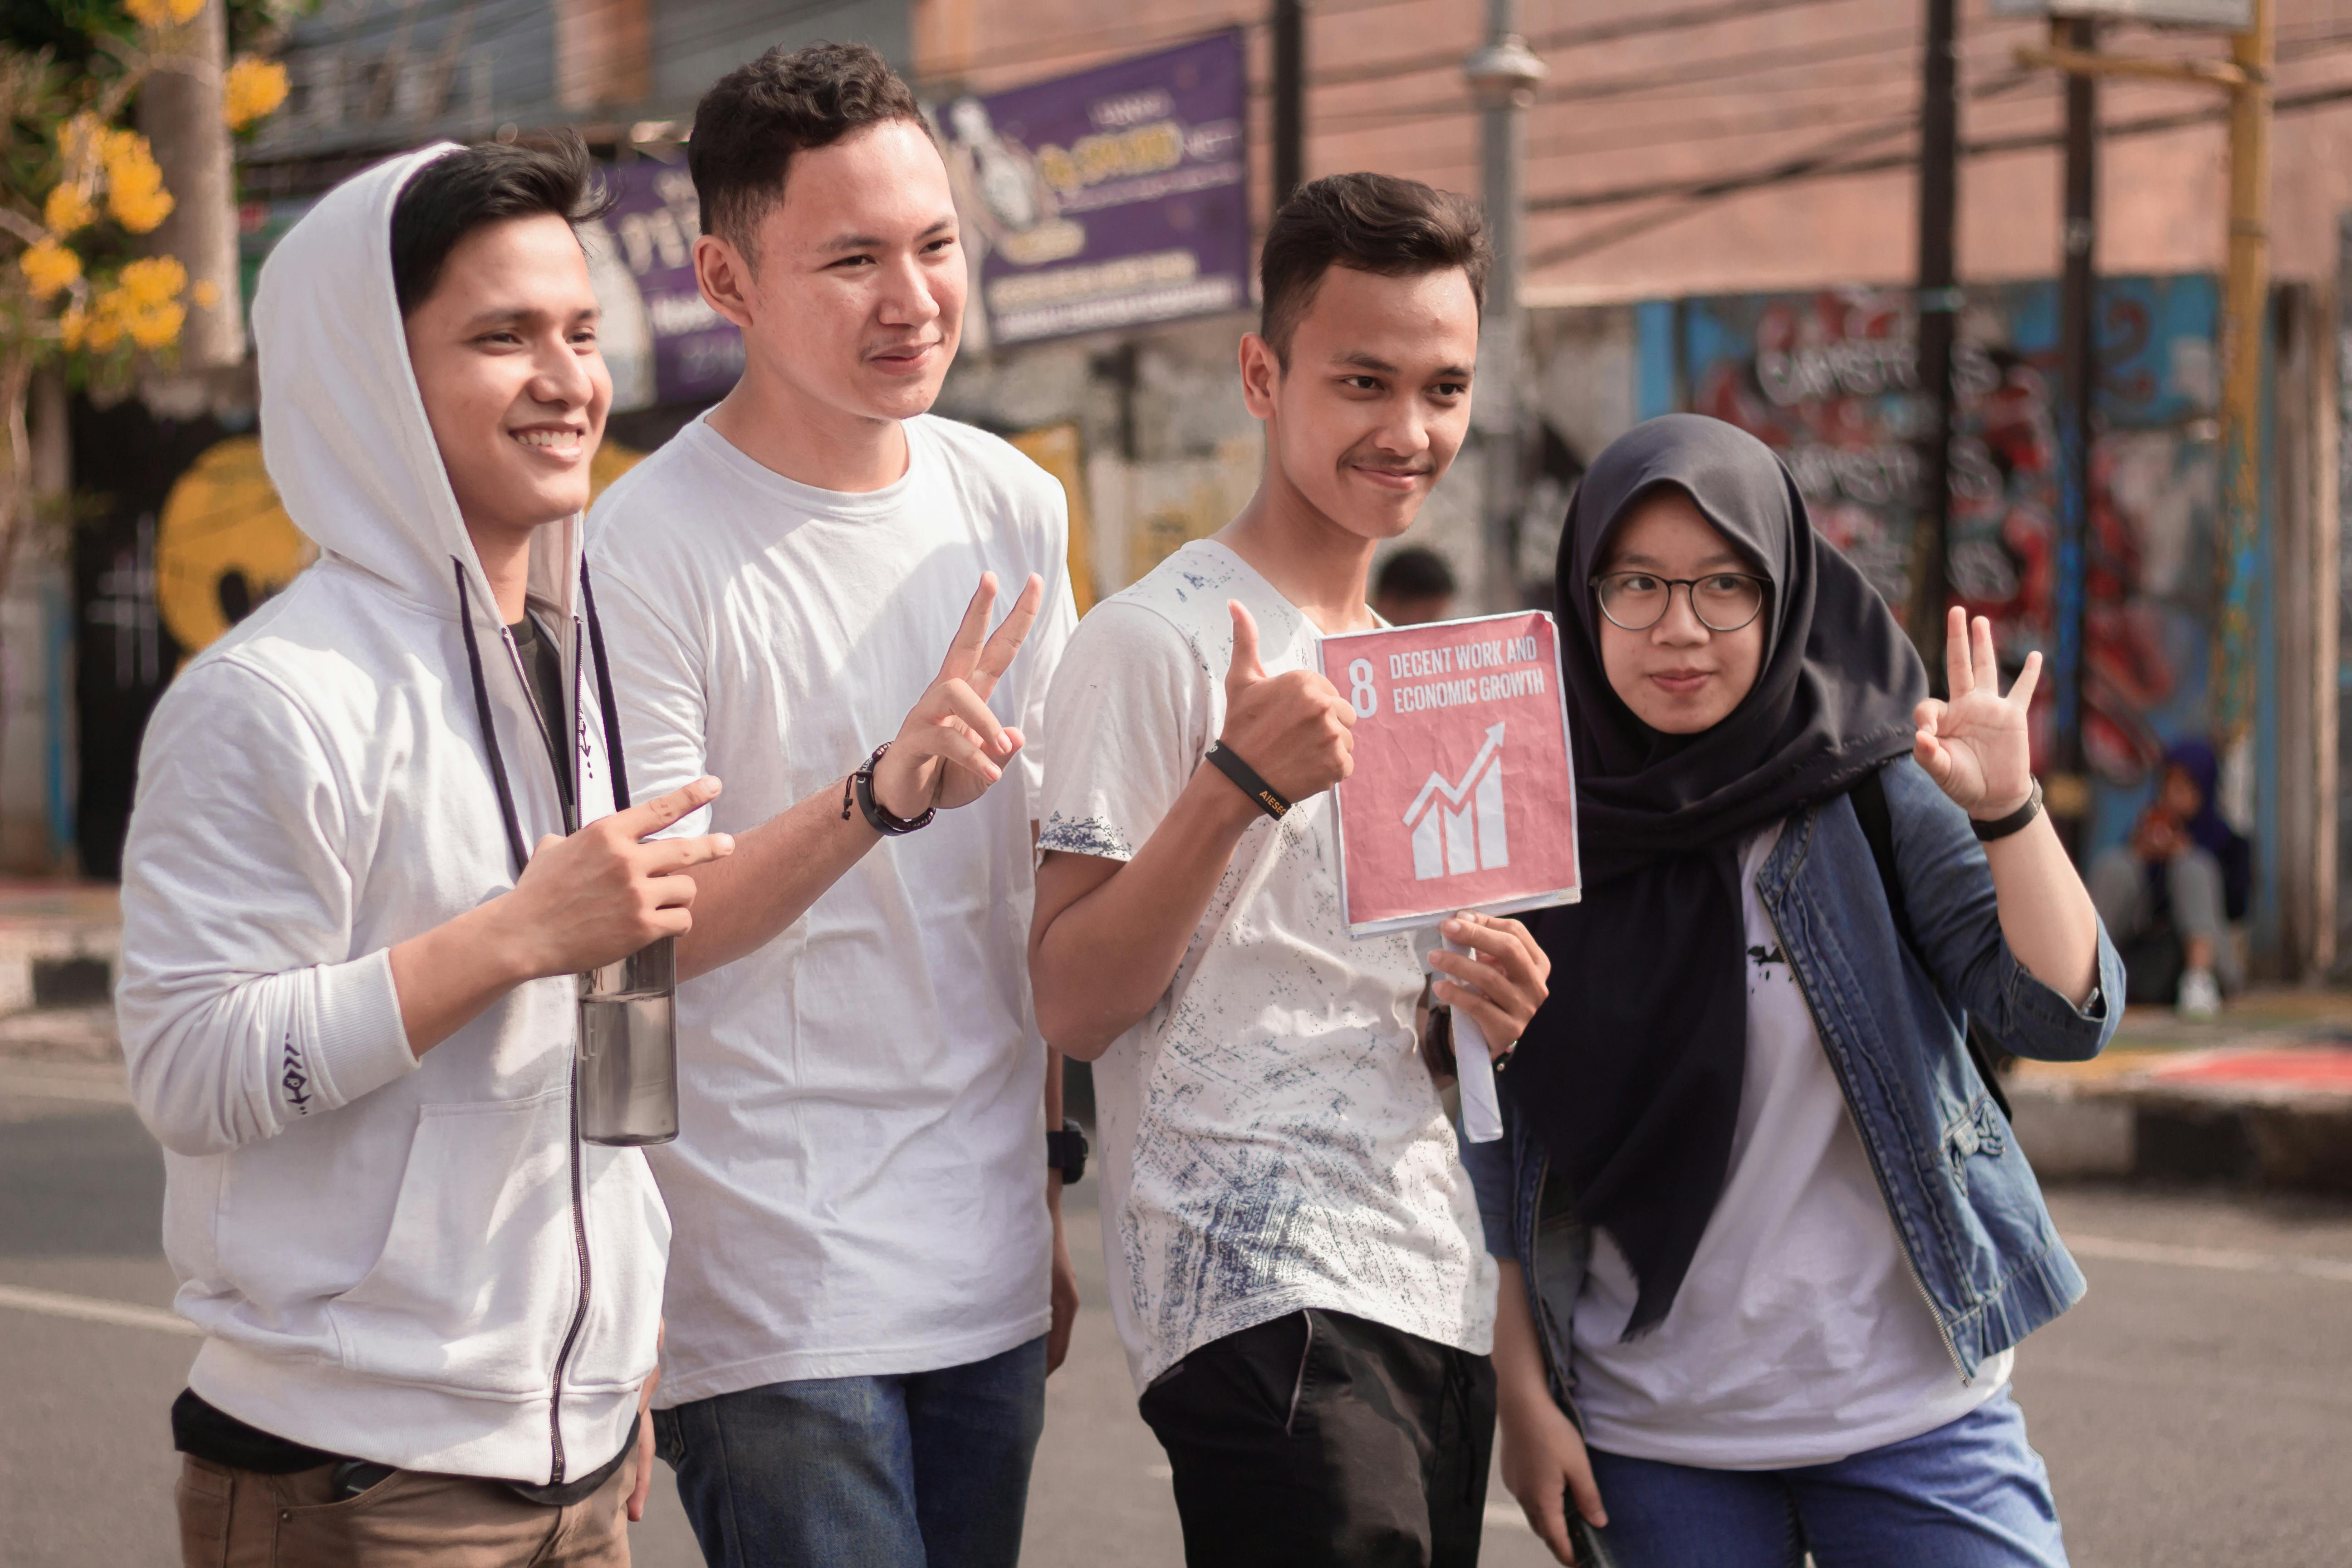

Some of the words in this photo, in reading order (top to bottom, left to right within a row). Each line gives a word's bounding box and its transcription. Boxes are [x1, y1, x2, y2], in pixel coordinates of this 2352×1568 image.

[1389, 647, 1452, 679] DECENT
[1455, 640, 1502, 670] WORK
[1506, 635, 1537, 664] AND
[1348, 658, 1378, 718] 8
[1392, 678, 1477, 714] ECONOMIC
[1480, 668, 1545, 701] GROWTH
[1259, 791, 1286, 815] AIESEC
